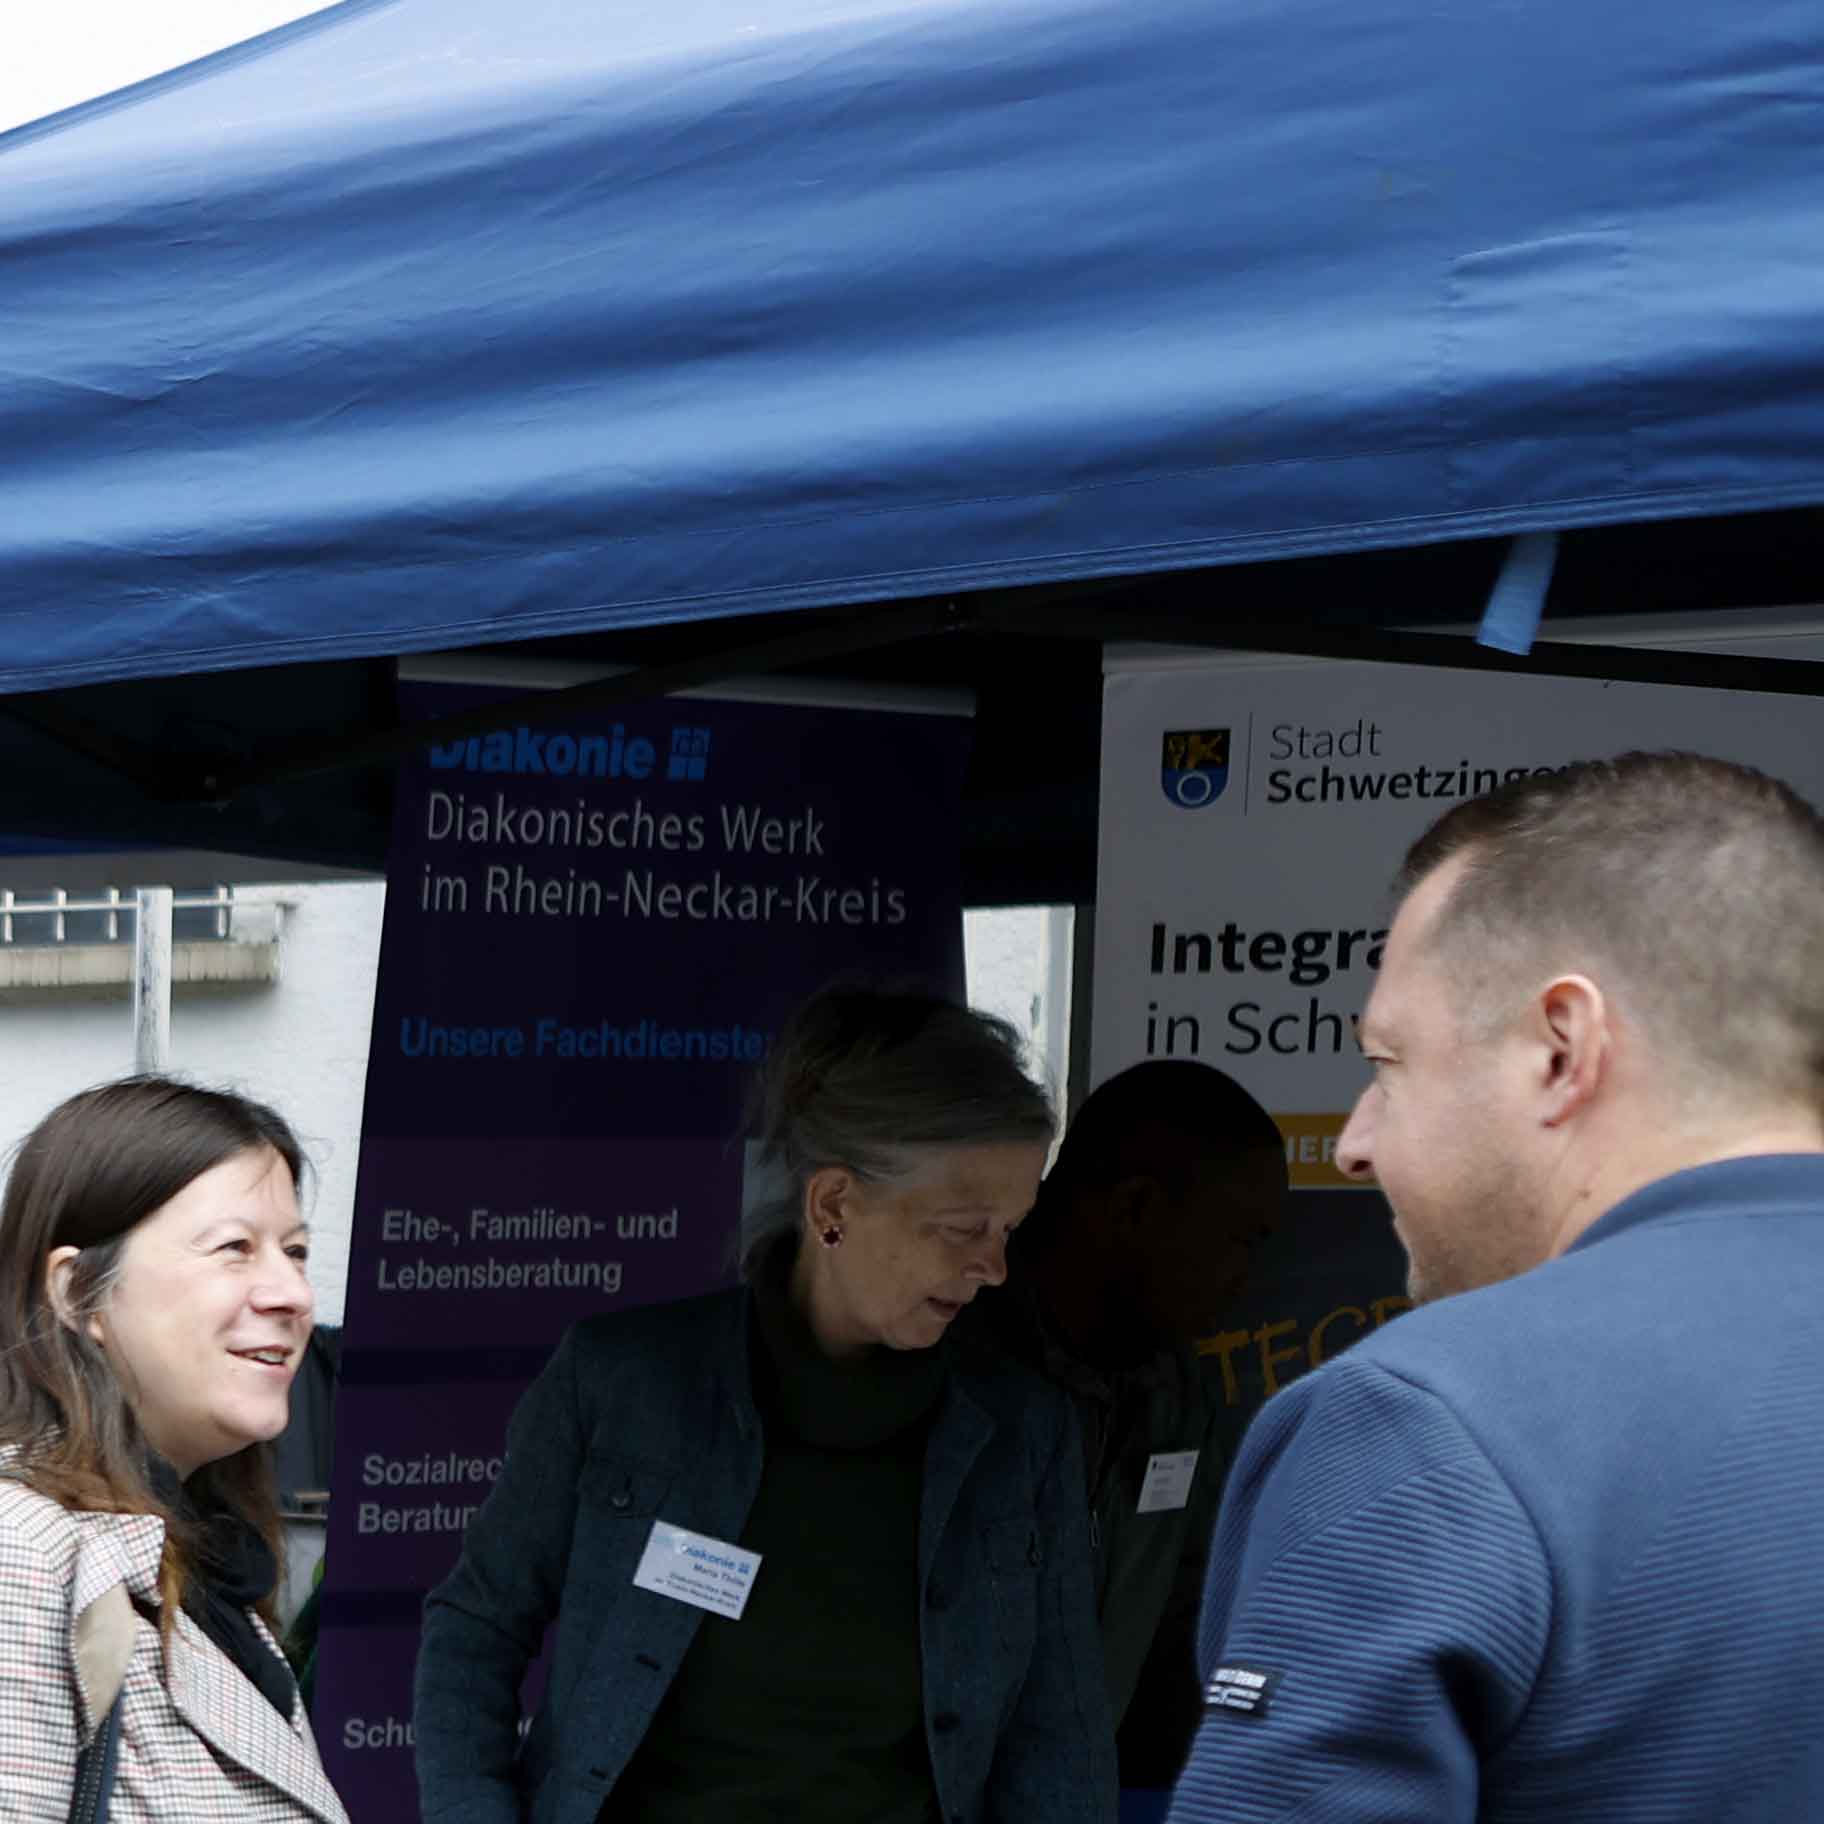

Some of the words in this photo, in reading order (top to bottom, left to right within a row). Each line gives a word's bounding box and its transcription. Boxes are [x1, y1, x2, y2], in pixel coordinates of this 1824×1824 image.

[1269, 718, 1383, 760] Stadt
[1266, 760, 1569, 803] Schwetzin
[425, 791, 706, 851] Diakonisches
[719, 801, 826, 856] Werk
[421, 863, 468, 913] im
[485, 864, 909, 928] Rhein-Neckar-Kreis
[399, 1015, 527, 1057] Unsere
[1146, 1001, 1200, 1055] in
[1224, 997, 1365, 1055] Sch
[381, 1208, 461, 1247] Ehe-,
[468, 1208, 607, 1242] Familien-
[615, 1208, 680, 1240] und
[376, 1257, 624, 1294] Lebensberatung
[361, 1452, 507, 1487] Sozialrec
